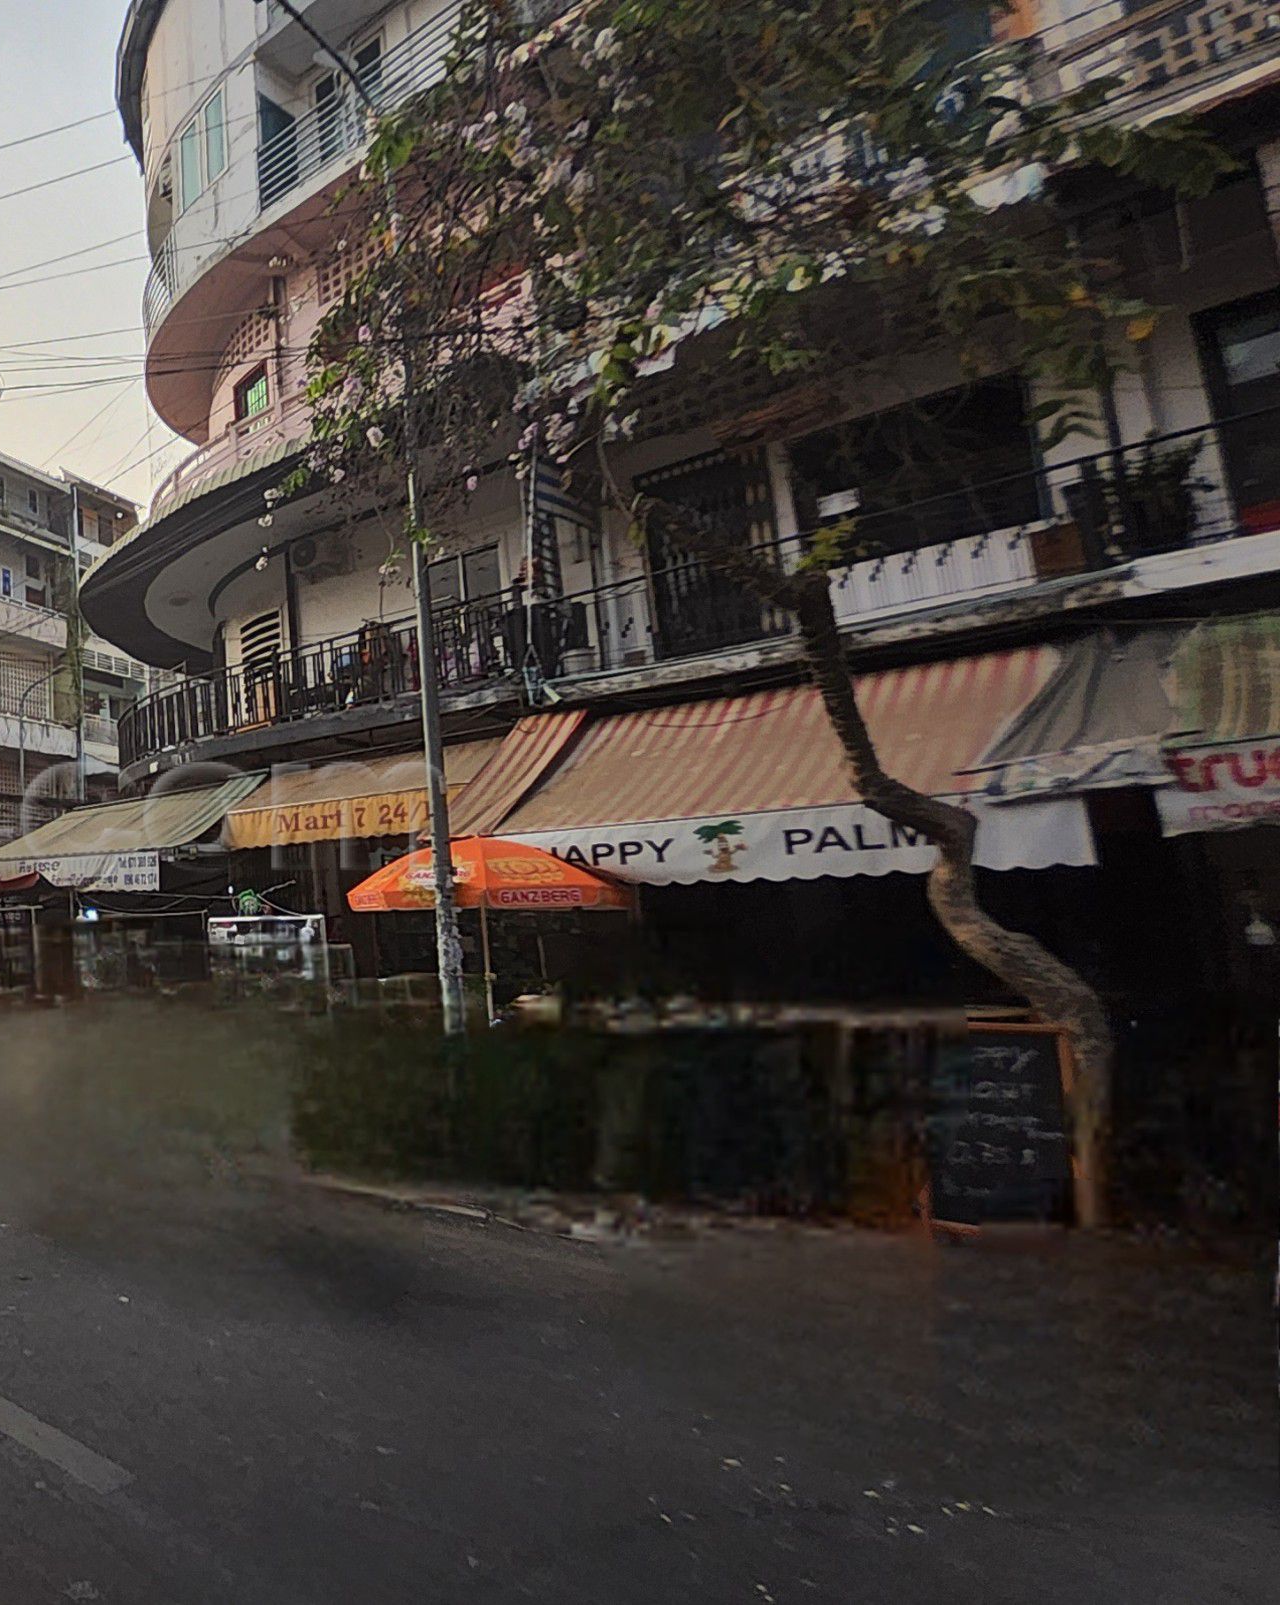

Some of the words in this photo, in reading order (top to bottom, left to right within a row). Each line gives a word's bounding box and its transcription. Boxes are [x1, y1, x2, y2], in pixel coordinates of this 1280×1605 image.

[277, 808, 342, 834] Mart
[353, 807, 366, 828] 7
[500, 889, 582, 904] GANZBERG
